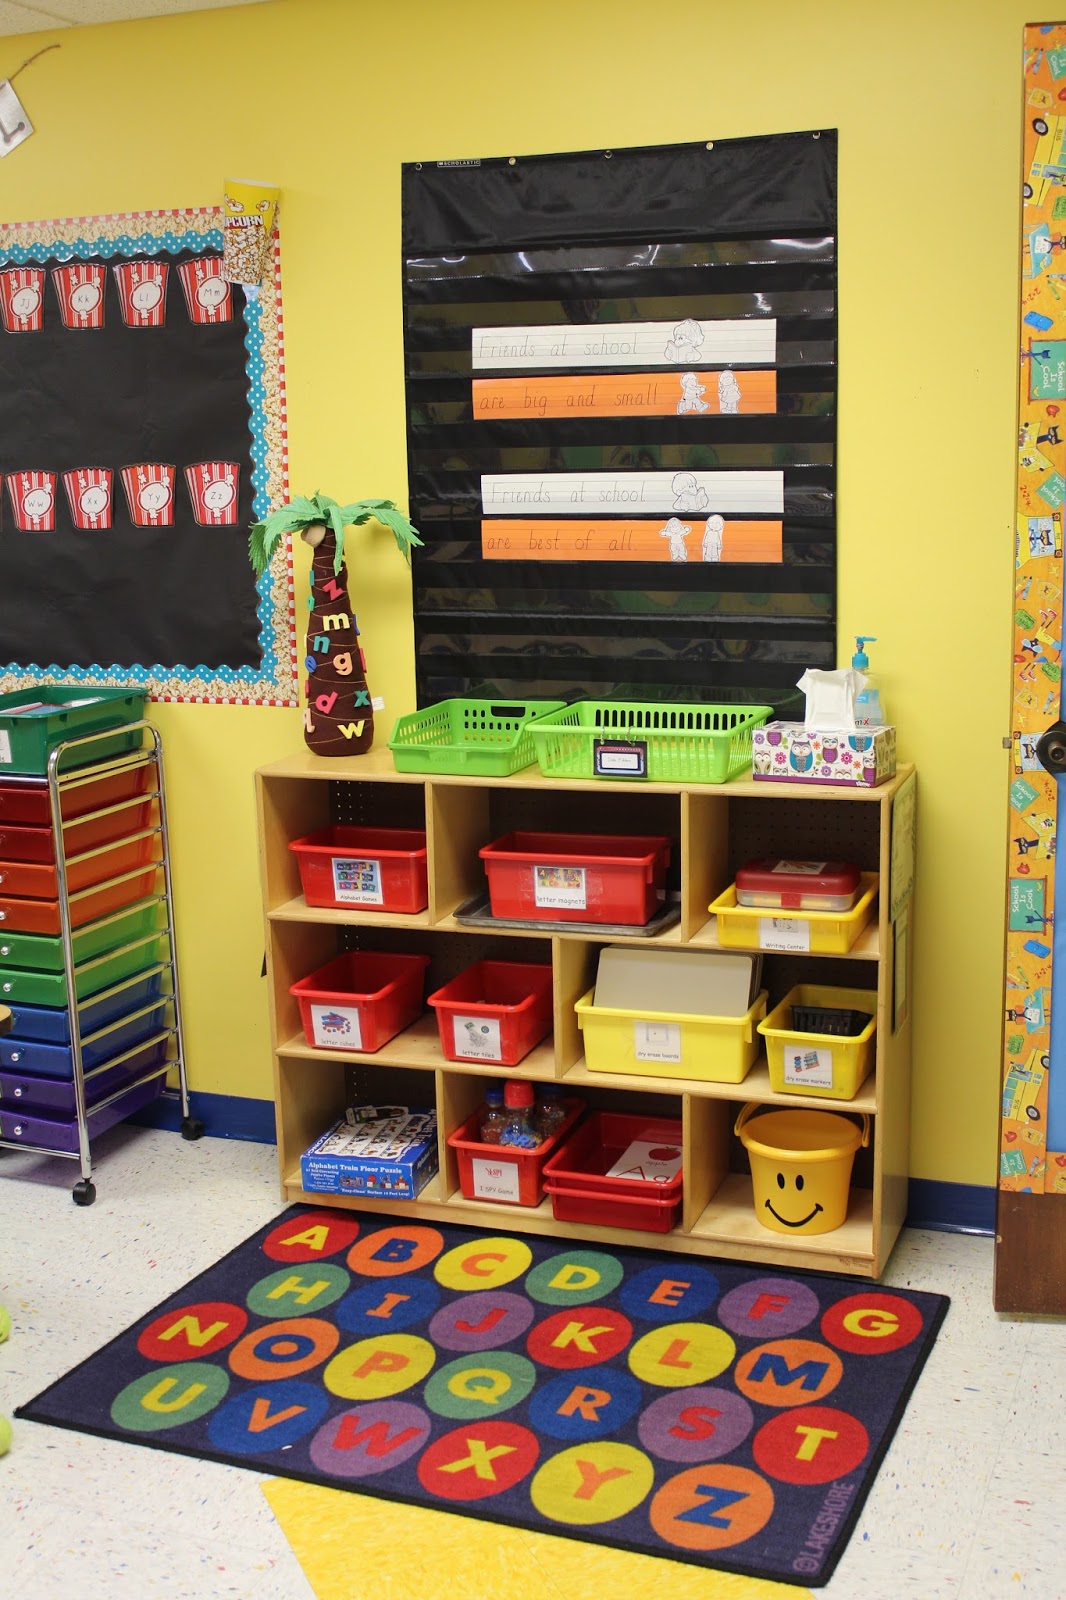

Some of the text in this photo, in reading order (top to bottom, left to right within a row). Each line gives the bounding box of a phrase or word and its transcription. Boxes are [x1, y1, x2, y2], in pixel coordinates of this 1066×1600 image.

[479, 332, 638, 358] Friends at school
[1050, 373, 1058, 382] Is
[480, 394, 505, 410] are
[525, 386, 548, 416] big
[566, 385, 596, 408] and
[490, 480, 646, 504] Friends at school
[1040, 484, 1060, 506] School
[486, 536, 512, 551] are
[528, 530, 561, 551] best
[574, 530, 594, 551] of
[322, 612, 350, 632] m
[313, 636, 330, 654] n
[333, 652, 353, 676] g
[316, 691, 338, 714] d
[1014, 780, 1034, 802] School
[1012, 884, 1020, 913] School
[1020, 894, 1026, 903] Is
[1025, 888, 1033, 911] Cool
[308, 1162, 338, 1170] Alphabet
[340, 1164, 358, 1172] Train
[616, 1166, 646, 1180] A
[1001, 1153, 1011, 1175] School
[278, 1224, 900, 1337] A B C D E F G
[266, 1276, 830, 1391] H I J K L M
[156, 1315, 838, 1462] N O P Q R S T
[140, 1377, 752, 1529] U V W X Y Z
